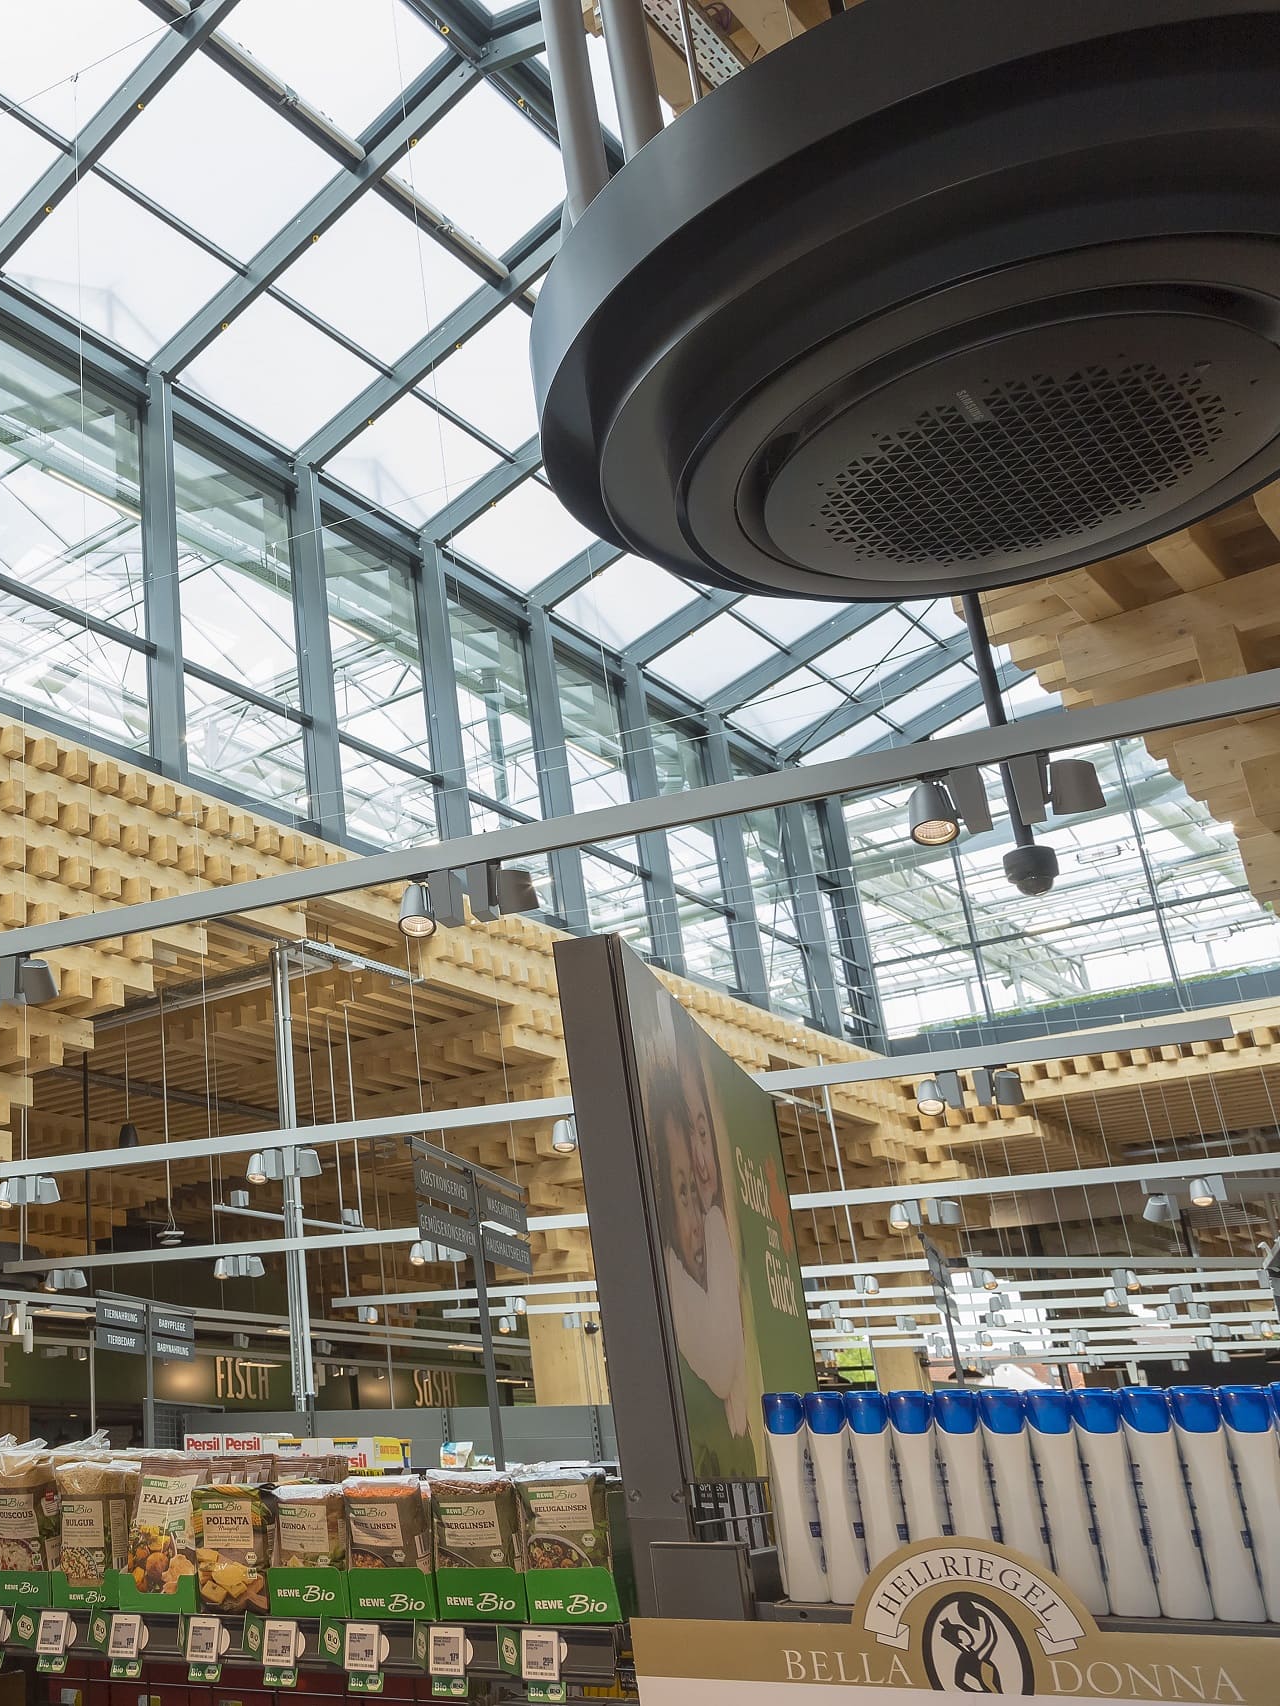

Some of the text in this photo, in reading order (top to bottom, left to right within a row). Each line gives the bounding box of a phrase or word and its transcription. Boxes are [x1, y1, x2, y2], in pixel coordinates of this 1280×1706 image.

[420, 1168, 468, 1201] OBSTKONSERVEN
[735, 1146, 773, 1221] Stück
[486, 1196, 521, 1223] WASCHMITTEL
[420, 1213, 476, 1247] GEMÜSEKONSERVEN
[765, 1250, 799, 1318] Glück
[103, 1308, 138, 1323] TIERNAHRUNG
[158, 1318, 186, 1332] BABYPFLEGE
[107, 1334, 136, 1348] TIERBEDARF
[156, 1342, 189, 1357] BABYNAHRUNG
[215, 1356, 269, 1400] FISCH
[186, 1437, 220, 1451] Persil
[225, 1437, 261, 1451] Persil
[143, 1493, 189, 1505] FALAFEL
[555, 1489, 577, 1501] Bio
[296, 1507, 316, 1518] Bio
[366, 1507, 387, 1518] Bio
[463, 1506, 485, 1517] Bio
[534, 1505, 587, 1513] BELUGALINSEN
[65, 1519, 95, 1527] BULGUR
[206, 1517, 249, 1526] POLENTA
[281, 1522, 306, 1530] QUINOA
[369, 1522, 397, 1530] LINSEN
[445, 1520, 495, 1530] BERGLINSEN
[19, 1581, 39, 1593] Bio
[277, 1585, 335, 1603] REWE Bio
[875, 1554, 1062, 1624] HELLRIEGEL
[85, 1591, 106, 1603] Bio
[359, 1594, 425, 1612] REWE Bio
[446, 1592, 516, 1612] REWE Bio
[534, 1594, 608, 1615] REWE Bio
[781, 1649, 1246, 1703] BELLA DONNA
[434, 1682, 447, 1692] Bio
[530, 1687, 543, 1697] Bio
